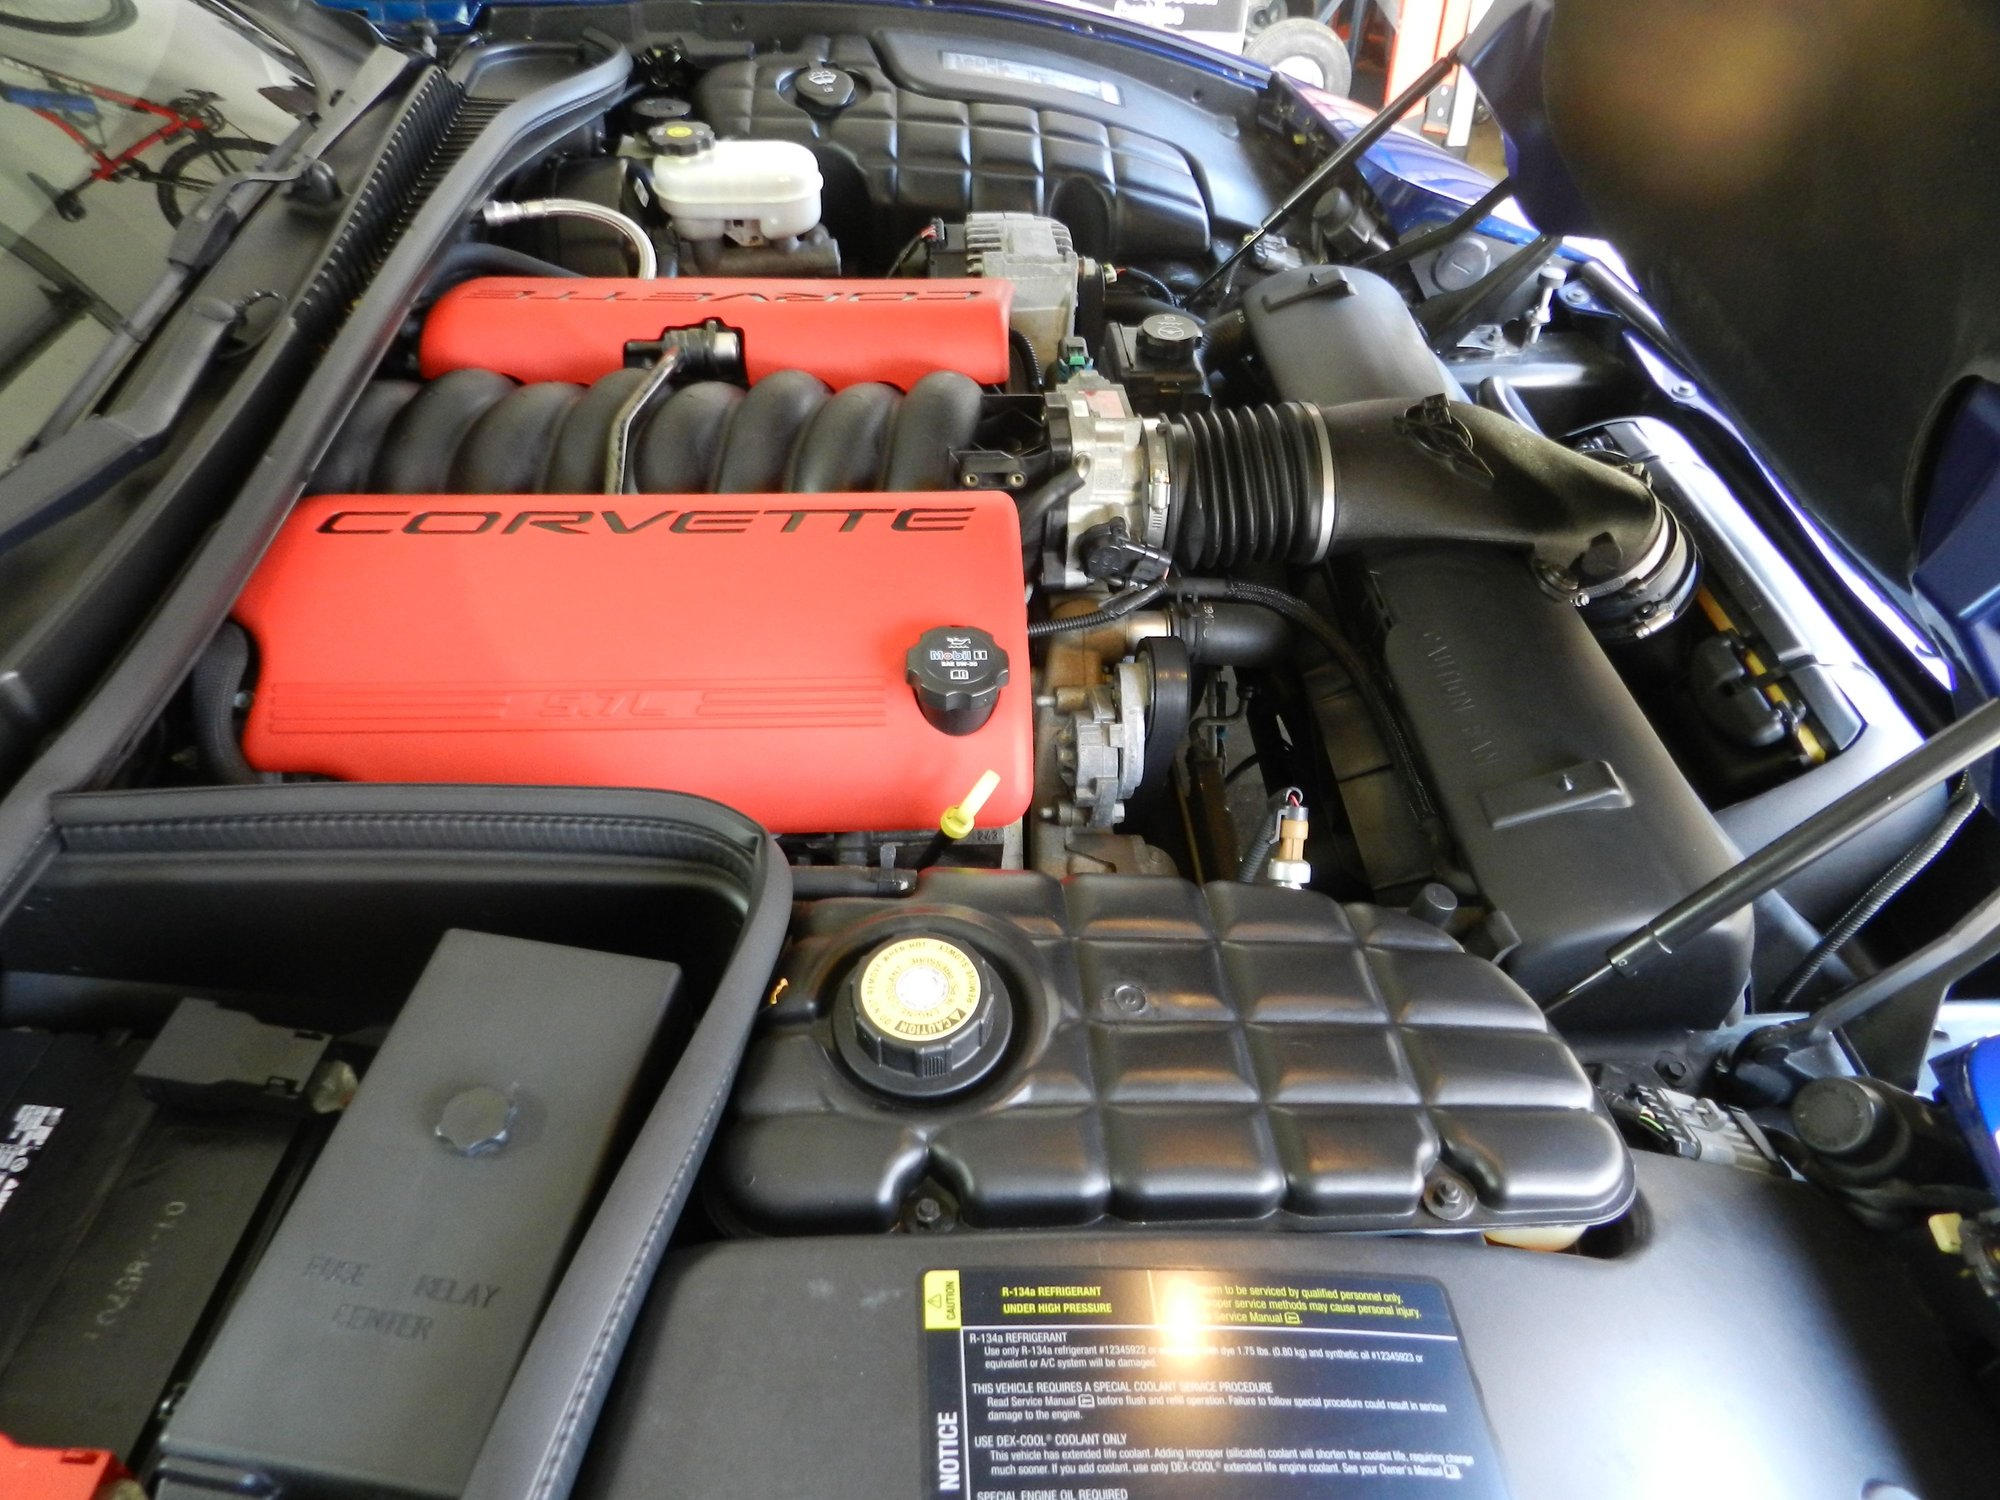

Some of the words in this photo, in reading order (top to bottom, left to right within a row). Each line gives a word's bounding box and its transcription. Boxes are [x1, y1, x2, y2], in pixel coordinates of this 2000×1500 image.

[315, 508, 977, 535] CORVETTE
[930, 650, 971, 660] Mobil
[538, 692, 667, 717] 5.7L
[898, 1018, 952, 1034] CAUTION
[303, 1256, 371, 1287] FUSE
[413, 1274, 501, 1308] RELAY
[1002, 1286, 1036, 1297] R-134a
[1038, 1286, 1101, 1297] REFRIGERANT
[1225, 1287, 1233, 1295] to
[1236, 1285, 1248, 1295] be
[1250, 1285, 1287, 1297] serviced
[1288, 1287, 1300, 1298] by
[1301, 1288, 1338, 1299] qualified
[1340, 1290, 1382, 1301] personnel
[946, 1281, 955, 1320] CAUTION
[1003, 1303, 1036, 1314] UNDER
[1039, 1303, 1061, 1314] HIGH
[1063, 1303, 1112, 1314] PRESSURE
[1235, 1300, 1266, 1309] service
[1269, 1300, 1308, 1311] methods
[1309, 1302, 1328, 1313] may
[1330, 1304, 1356, 1313] cause
[1358, 1305, 1394, 1316] personal
[333, 1303, 434, 1341] CENTER
[1250, 1312, 1283, 1323] Manual
[969, 1332, 1003, 1343] R-134a
[1006, 1332, 1067, 1343] REFRIGERANT
[984, 1346, 1000, 1356] Use
[1002, 1346, 1019, 1357] only
[1021, 1346, 1052, 1356] R-134a
[1054, 1346, 1097, 1357] refrigerant
[1221, 1346, 1235, 1357] dye
[1237, 1346, 1255, 1356] 1.75
[1294, 1347, 1308, 1359] kg)
[1309, 1348, 1323, 1357] and
[1325, 1349, 1359, 1360] synthetic
[1360, 1350, 1370, 1360] oil
[1415, 1354, 1424, 1363] or
[985, 1357, 1028, 1369] equivalent
[1040, 1357, 1055, 1368] A/C
[1058, 1359, 1086, 1369] system
[1089, 1357, 1103, 1367] will
[1105, 1357, 1116, 1367] be
[972, 1383, 993, 1394] THIS
[995, 1382, 1034, 1394] VEHICLE
[1037, 1382, 1082, 1393] REQUIRES
[1084, 1382, 1092, 1392] A
[1093, 1381, 1131, 1392] SPECIAL
[1134, 1381, 1176, 1392] COOLANT
[1179, 1382, 1217, 1392] SERVICE
[1219, 1382, 1273, 1393] PROCEDURE
[987, 1396, 1009, 1407] Read
[1011, 1396, 1043, 1407] Service
[1045, 1396, 1076, 1406] Manual
[1097, 1396, 1123, 1406] before
[1125, 1395, 1147, 1405] flush
[1149, 1395, 1164, 1405] and
[1228, 1395, 1256, 1405] Failure
[1258, 1396, 1266, 1405] to
[1268, 1395, 1292, 1406] follow
[1294, 1397, 1321, 1408] special
[1323, 1398, 1363, 1409] procedure
[1364, 1399, 1386, 1409] could
[1387, 1399, 1410, 1410] result
[1411, 1401, 1418, 1410] in
[1419, 1402, 1447, 1412] serious
[988, 1410, 1023, 1422] damage
[1025, 1411, 1033, 1420] to
[1035, 1410, 1050, 1419] the
[1051, 1410, 1083, 1421] engine.
[974, 1435, 993, 1447] USE
[1055, 1434, 1100, 1445] COOLANT
[1103, 1433, 1127, 1445] ONLY
[937, 1411, 960, 1491] NOTICE
[991, 1450, 1009, 1461] This
[1011, 1450, 1042, 1461] vehicle
[1044, 1450, 1059, 1460] has
[1062, 1449, 1101, 1460] extended
[1103, 1449, 1116, 1459] life
[1154, 1448, 1184, 1460] Adding
[1186, 1449, 1224, 1460] improper
[1226, 1448, 1266, 1460] (silicated)
[1267, 1449, 1298, 1459] coolant
[1299, 1448, 1313, 1459] will
[1315, 1449, 1346, 1460] shorten
[1348, 1449, 1361, 1460] the
[1363, 1450, 1391, 1461] coolant
[1410, 1453, 1445, 1465] requiring
[1445, 1454, 1474, 1466] change
[991, 1464, 1016, 1476] much
[1052, 1464, 1058, 1473] If
[1059, 1465, 1076, 1476] you
[1078, 1463, 1095, 1473] add
[1133, 1464, 1148, 1473] use
[1150, 1462, 1169, 1474] only
[1224, 1462, 1262, 1473] extended
[1264, 1462, 1277, 1473] life
[1279, 1463, 1306, 1474] engine
[1342, 1462, 1358, 1473] See
[1360, 1464, 1378, 1475] your
[1379, 1463, 1413, 1475] Owner's
[1413, 1465, 1444, 1476] Manual
[977, 1490, 1016, 1500] SPECIAL
[1020, 1490, 1057, 1500] ENGINE
[1060, 1489, 1075, 1500] OIL
[1078, 1488, 1128, 1500] REQUIRED
